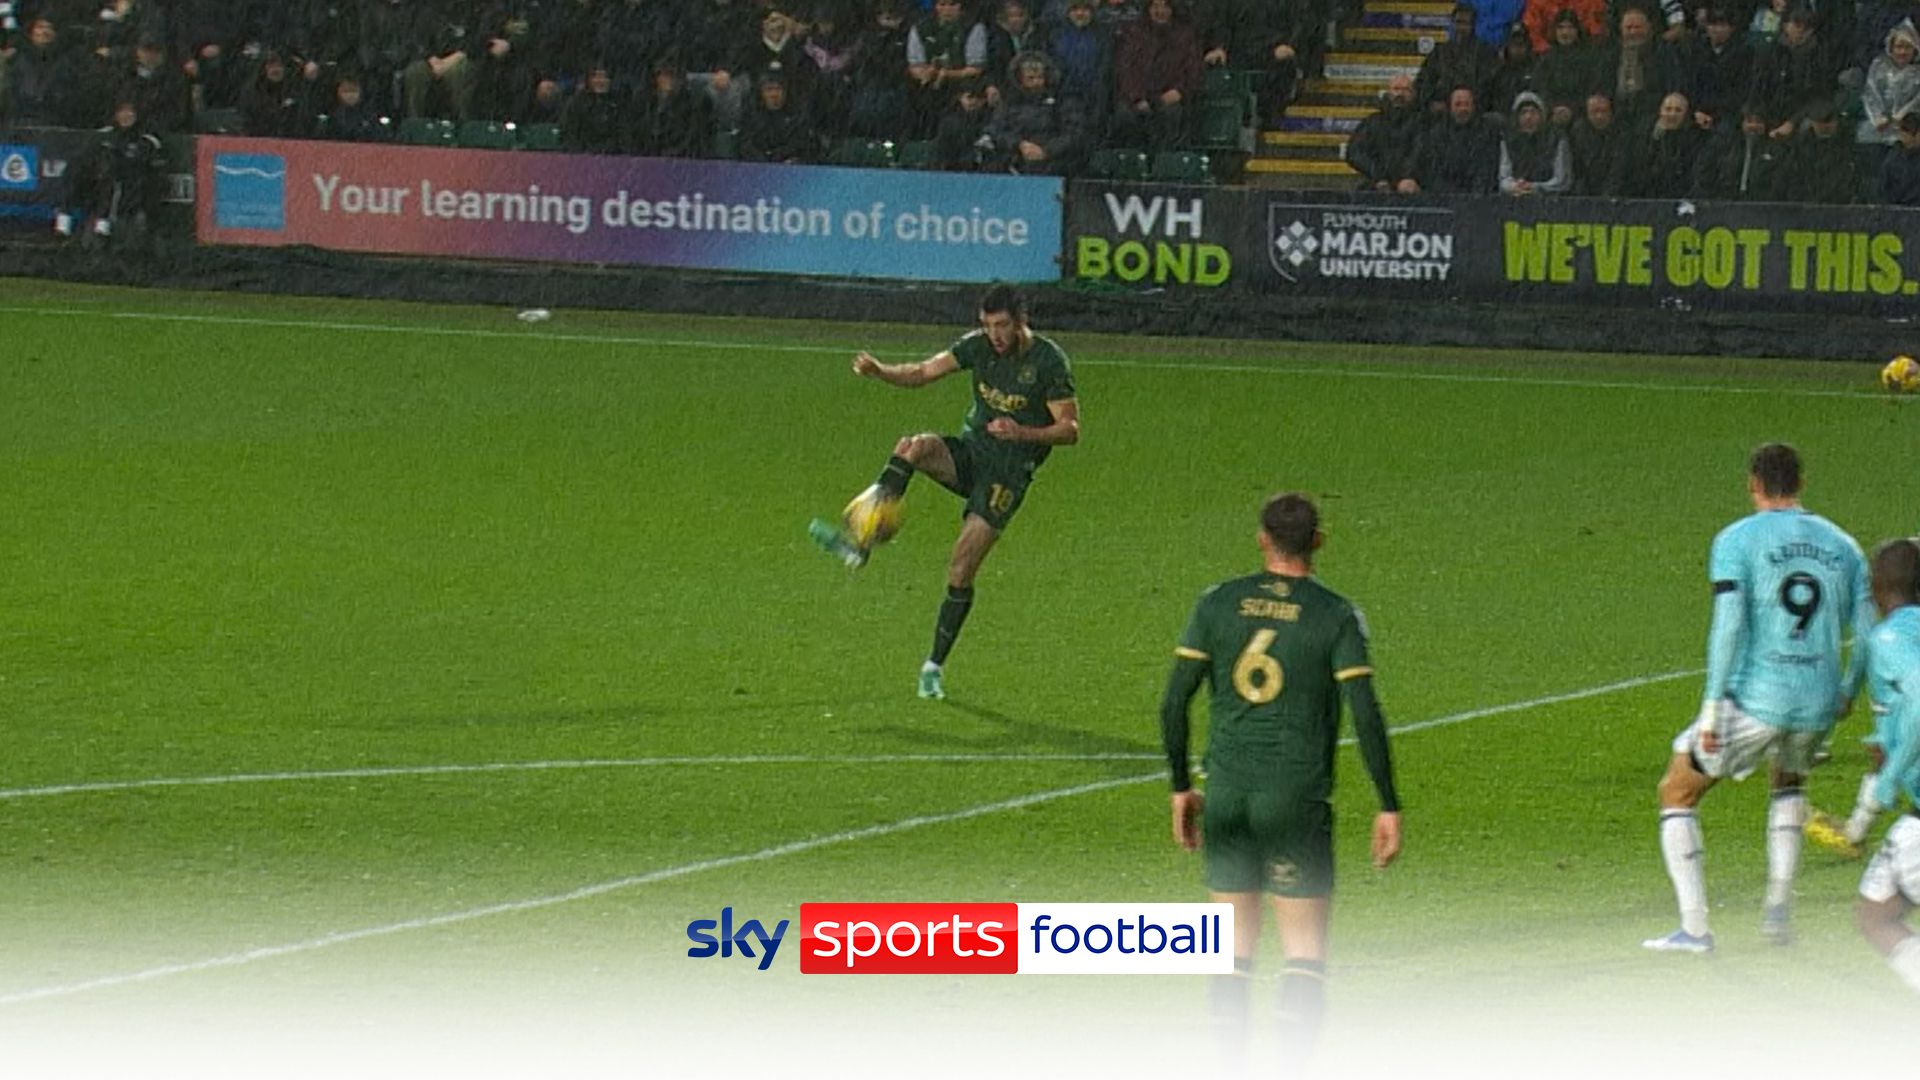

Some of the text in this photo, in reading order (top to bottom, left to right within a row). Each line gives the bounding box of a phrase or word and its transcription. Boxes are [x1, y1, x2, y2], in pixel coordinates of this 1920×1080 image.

[313, 174, 410, 215] Your
[421, 179, 592, 233] learning
[602, 190, 832, 237] destination
[843, 202, 885, 240] of
[895, 204, 1030, 247] choice
[1105, 192, 1202, 239] WH
[1322, 212, 1407, 230] PLYMOUTH
[1077, 236, 1232, 287] BOND
[1319, 260, 1452, 281] UNIVERSITY
[1321, 231, 1454, 259] MARJON
[1504, 221, 1919, 294] WE'VE GOT THIS.
[1780, 571, 1821, 639] 9
[1232, 628, 1284, 704] 6
